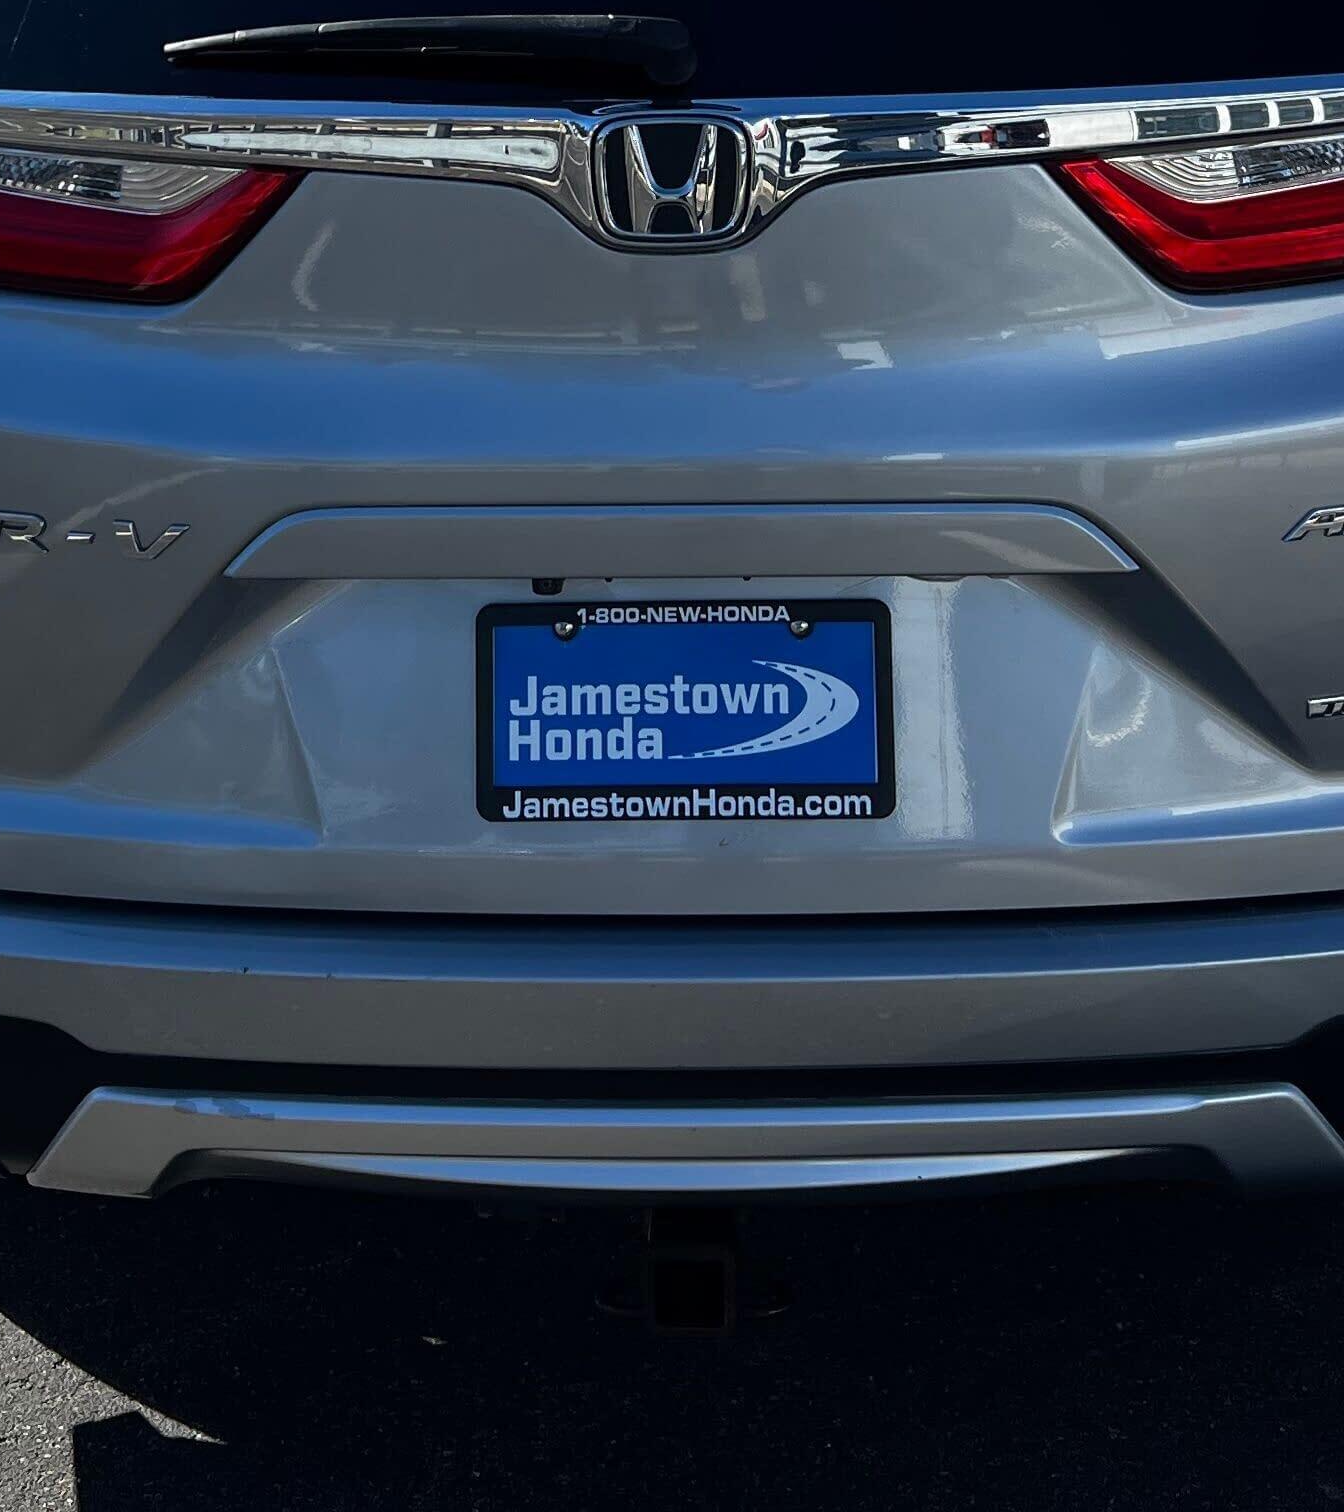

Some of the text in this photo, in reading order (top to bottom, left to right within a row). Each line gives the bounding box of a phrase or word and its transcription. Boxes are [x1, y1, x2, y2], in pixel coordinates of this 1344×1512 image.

[577, 604, 791, 626] 1-800-NEW-HONDA
[509, 675, 790, 717] Jamestown
[509, 716, 664, 761] Honda
[502, 788, 873, 819] JamestownHonda.com
